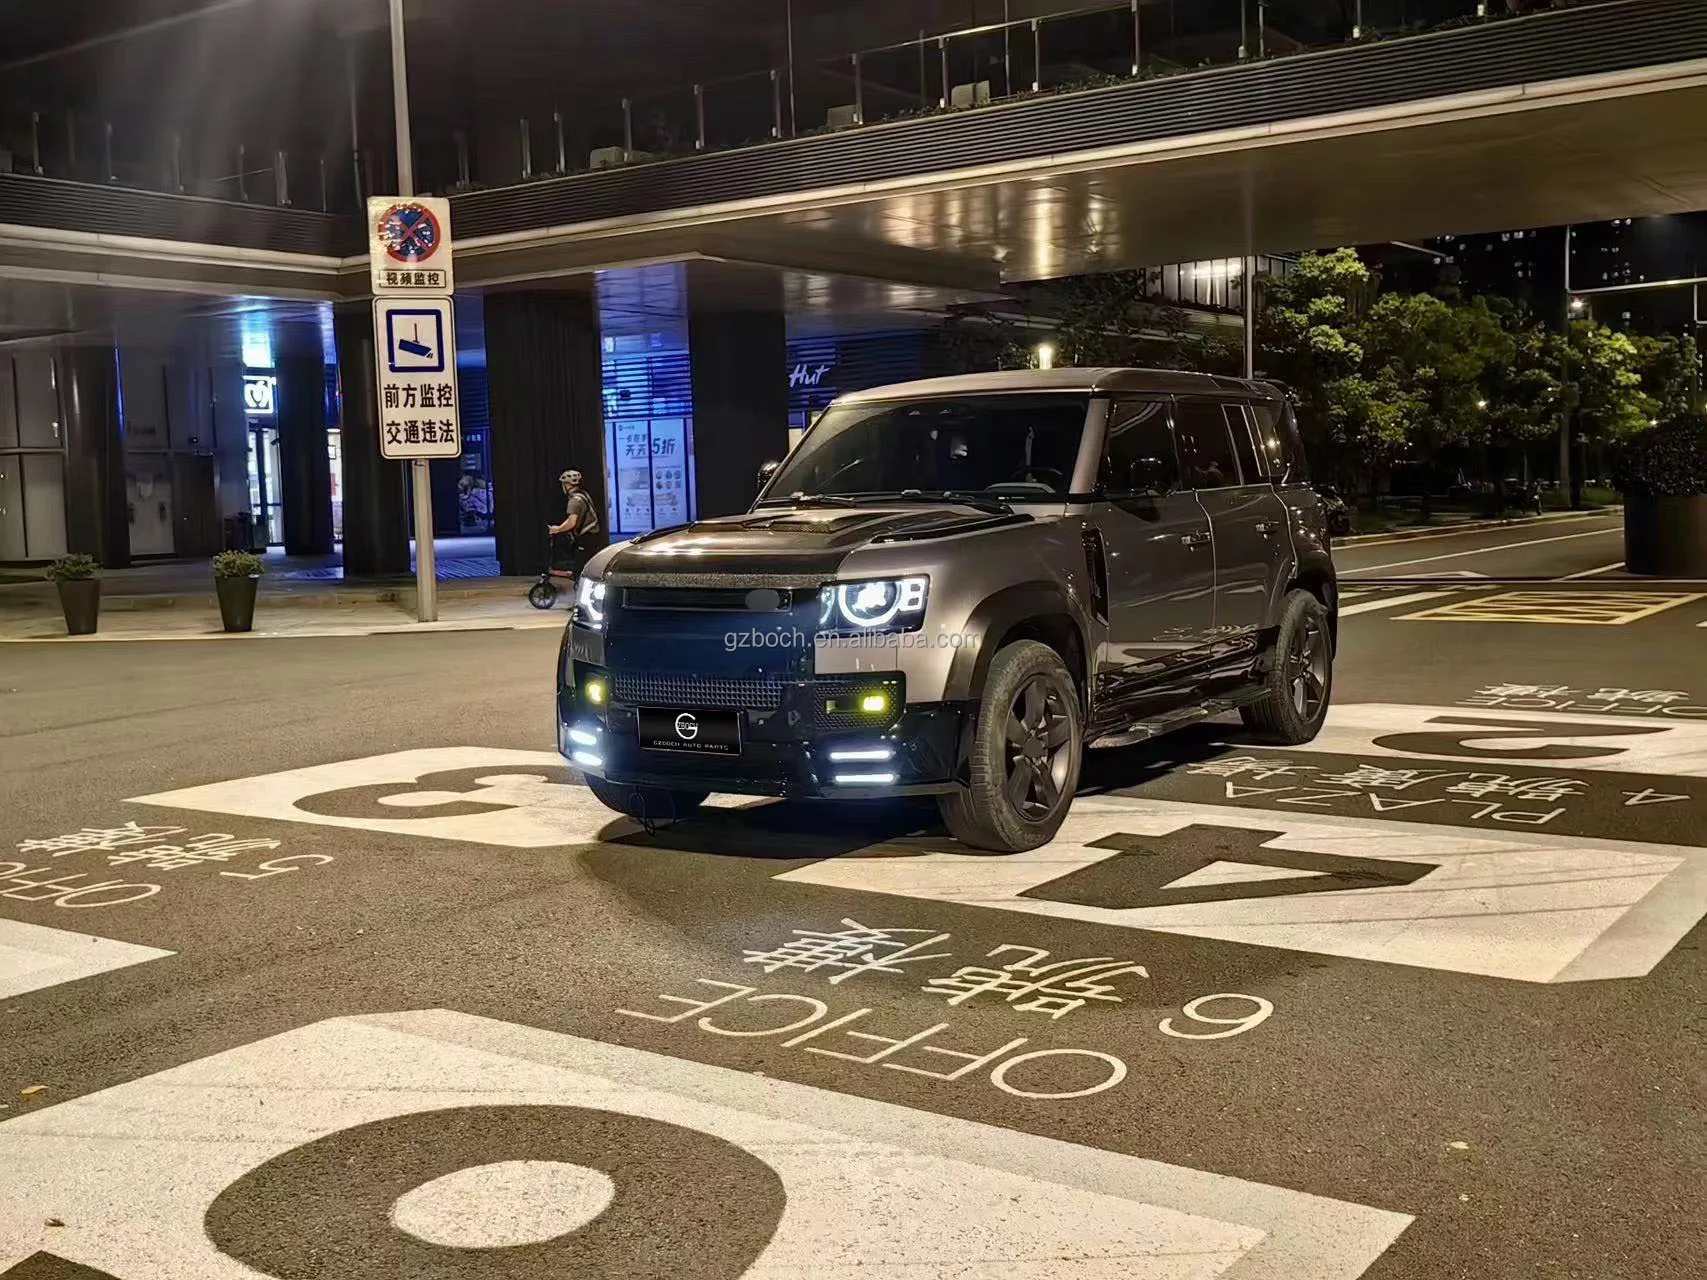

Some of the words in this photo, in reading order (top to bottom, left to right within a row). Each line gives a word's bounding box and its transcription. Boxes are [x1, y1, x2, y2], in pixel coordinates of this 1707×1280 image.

[386, 272, 440, 285] 视频监控
[788, 364, 830, 387] Hut
[383, 383, 454, 408] 前方监控
[386, 419, 455, 444] 交通违法
[1226, 781, 1566, 825] PLAZA
[615, 978, 1128, 1100] OFFICE
